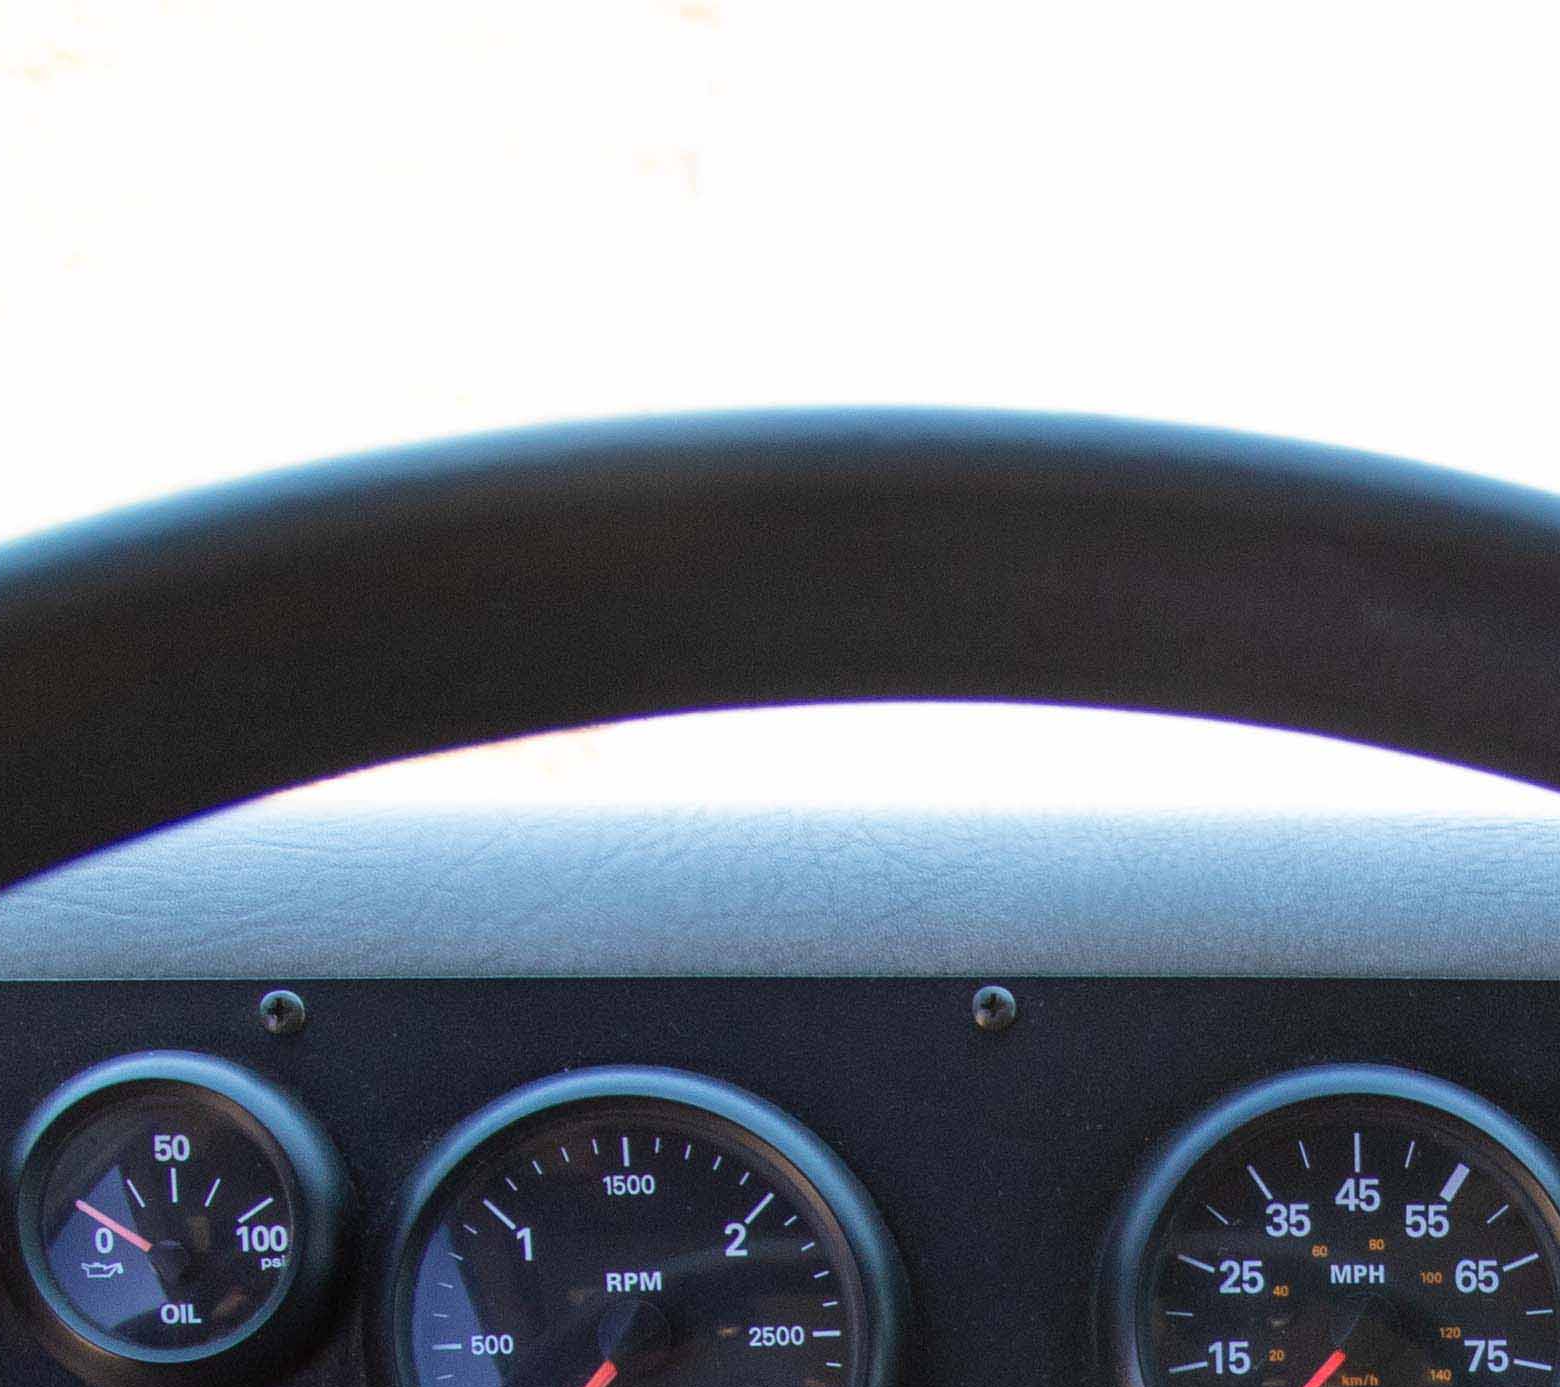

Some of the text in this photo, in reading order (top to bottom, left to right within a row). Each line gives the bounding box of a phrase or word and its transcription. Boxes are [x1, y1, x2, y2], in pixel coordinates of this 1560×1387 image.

[153, 1134, 190, 1163] 50
[602, 1175, 656, 1196] 1500
[1334, 1178, 1381, 1212] 45
[1265, 1203, 1311, 1237] 35
[1404, 1204, 1450, 1238] 55
[94, 1228, 113, 1255] 0
[236, 1226, 287, 1253] 100
[516, 1228, 534, 1261] 1
[724, 1223, 749, 1257] 2
[1311, 1245, 1328, 1258] 60
[260, 1255, 286, 1271] psi
[605, 1271, 663, 1293] RPM
[1219, 1260, 1264, 1294] 25
[1330, 1264, 1385, 1284] MPH
[1420, 1272, 1443, 1285] 100
[1455, 1260, 1500, 1294] 65
[1273, 1285, 1289, 1297] 40
[160, 1304, 202, 1325] OIL
[748, 1326, 805, 1346] 2500
[1440, 1326, 1461, 1339] 120
[470, 1335, 514, 1355] 500
[1208, 1341, 1251, 1374] 15
[1268, 1350, 1284, 1362] 20
[1463, 1340, 1508, 1373] 75
[1341, 1374, 1379, 1387] km/h
[1429, 1369, 1452, 1382] 140
